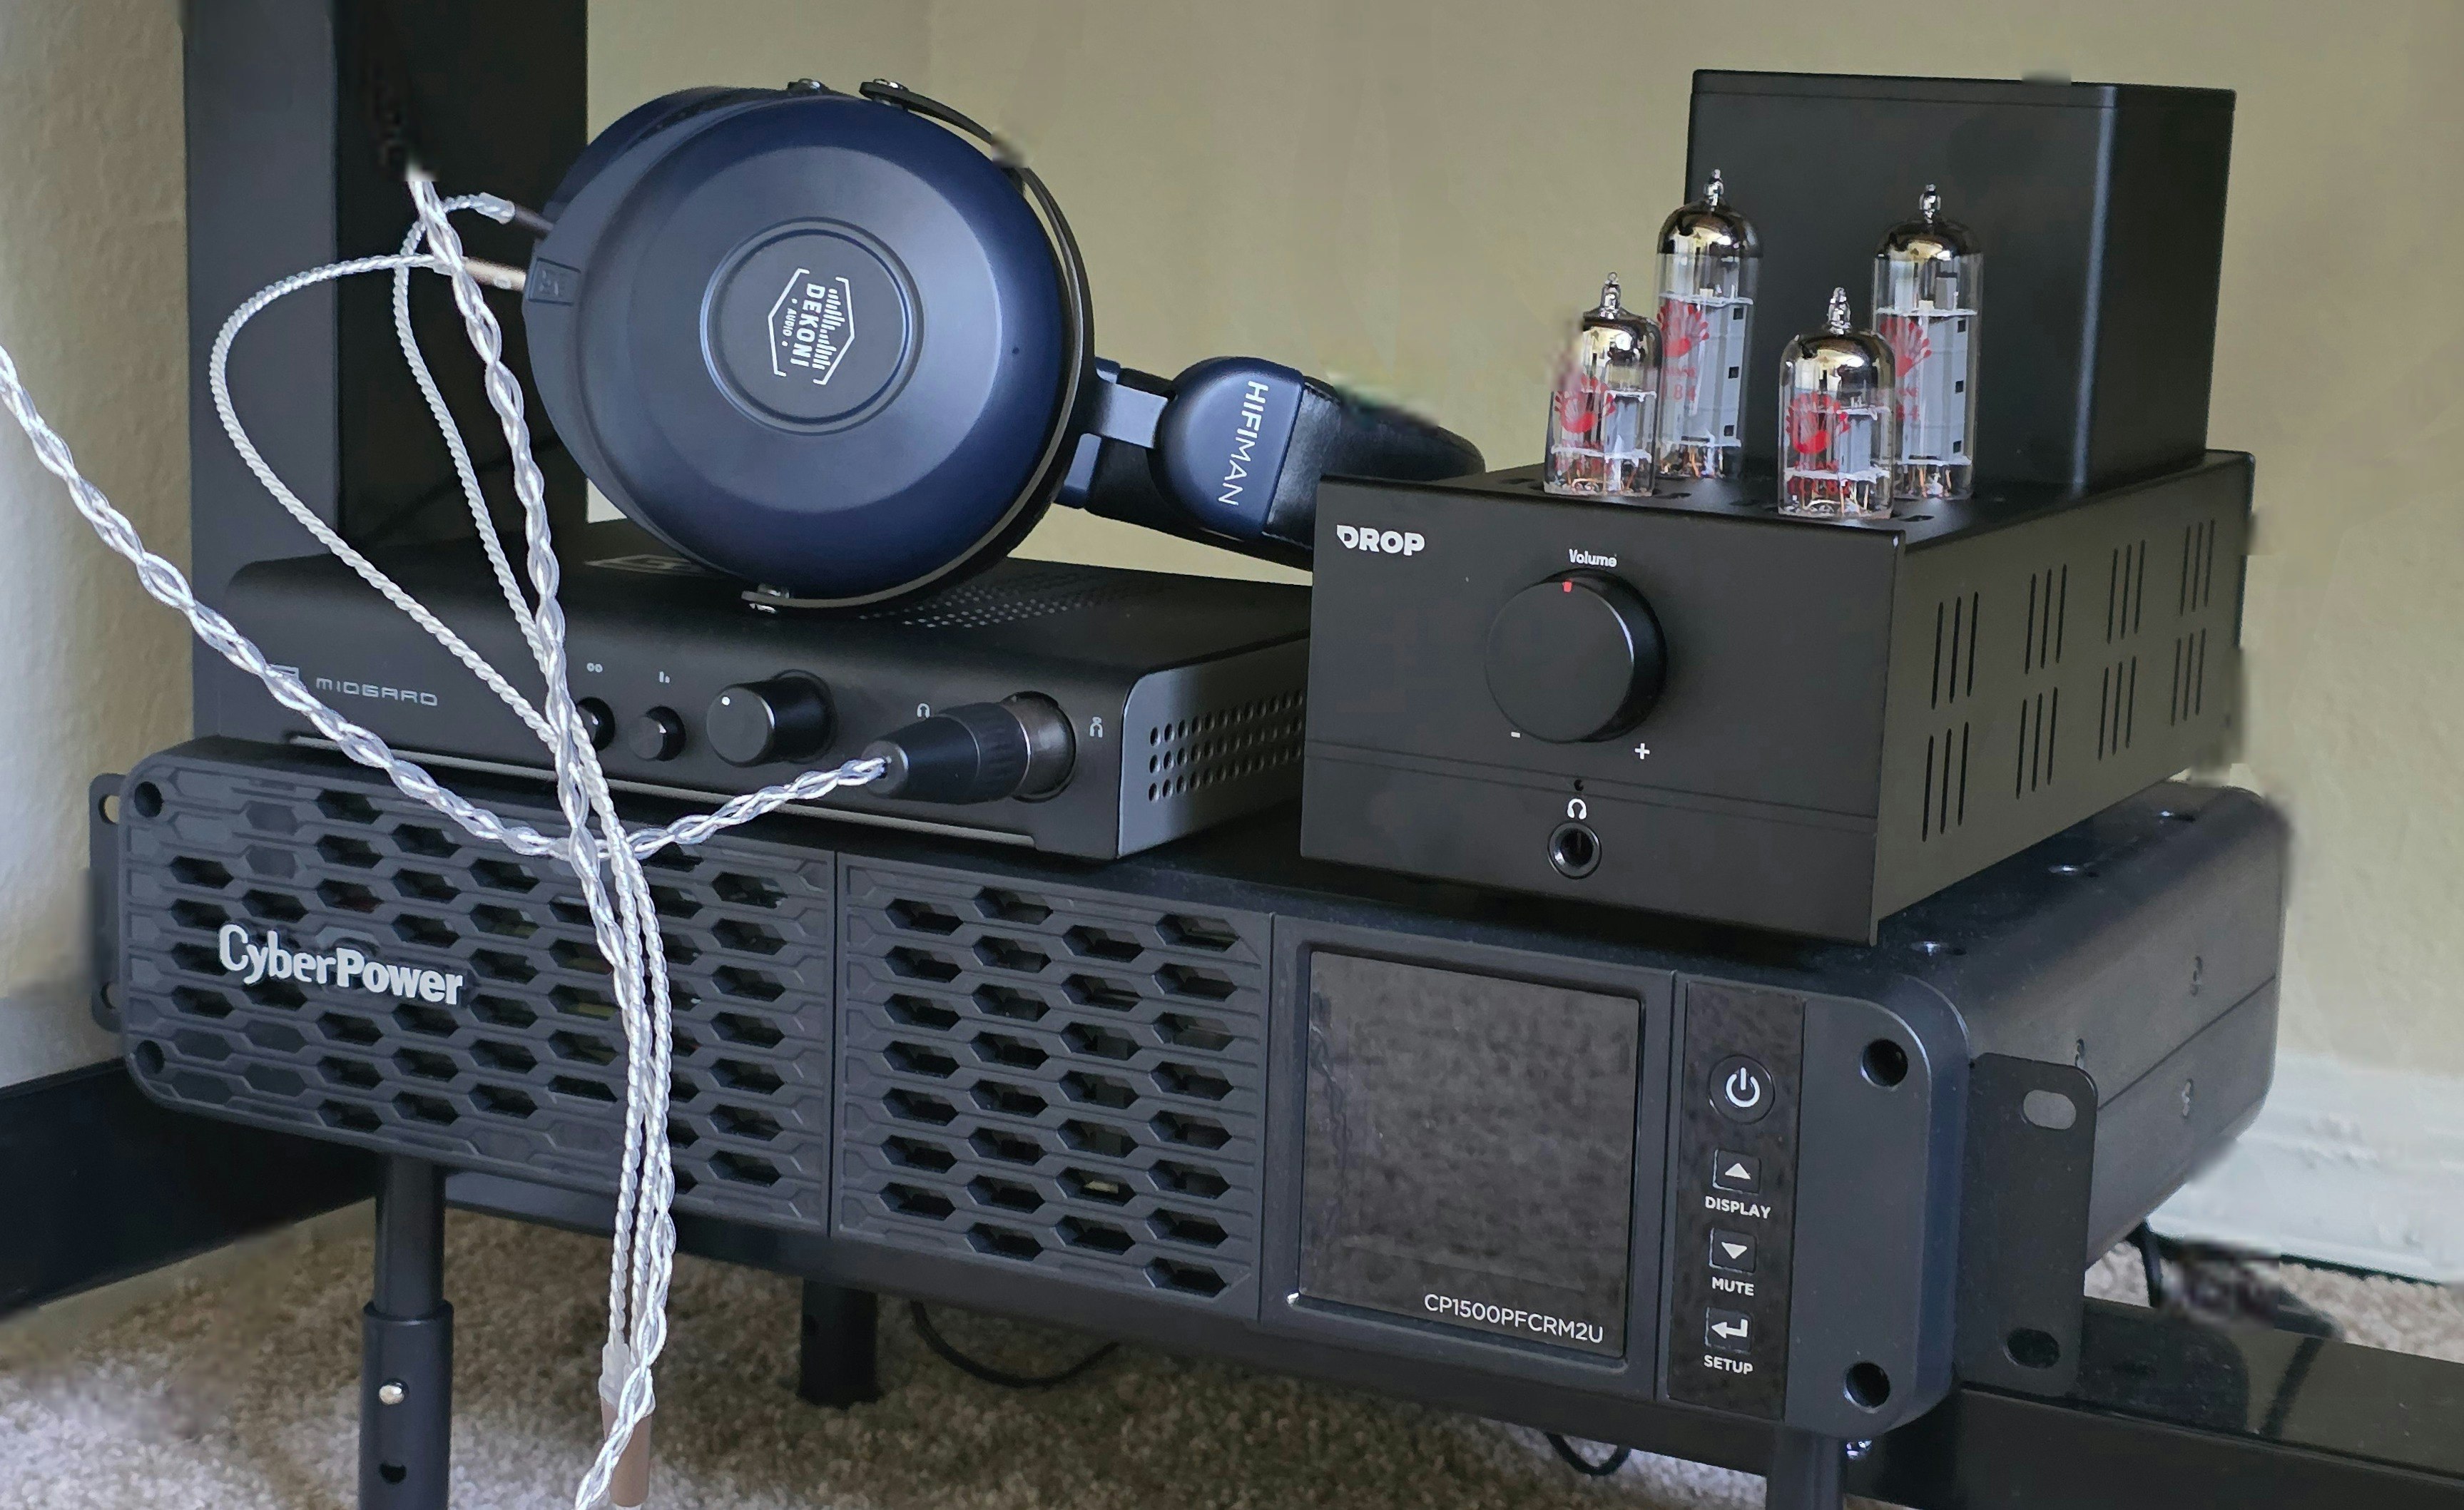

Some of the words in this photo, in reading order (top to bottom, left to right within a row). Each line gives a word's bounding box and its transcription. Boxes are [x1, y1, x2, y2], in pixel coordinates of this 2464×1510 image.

[782, 307, 797, 337] AUDIO
[790, 283, 825, 367] DEKONI
[1218, 380, 1269, 506] HIFIMAN
[1336, 524, 1425, 556] DROP
[1569, 549, 1617, 568] Volume
[316, 678, 438, 707] MIDGARD
[218, 924, 464, 1006] CyberPower
[1705, 1195, 1771, 1220] DISPLAY
[1711, 1276, 1755, 1296] MUTE
[1424, 1293, 1604, 1344] CP1500PFCRM2U
[1704, 1355, 1754, 1375] SETUP
